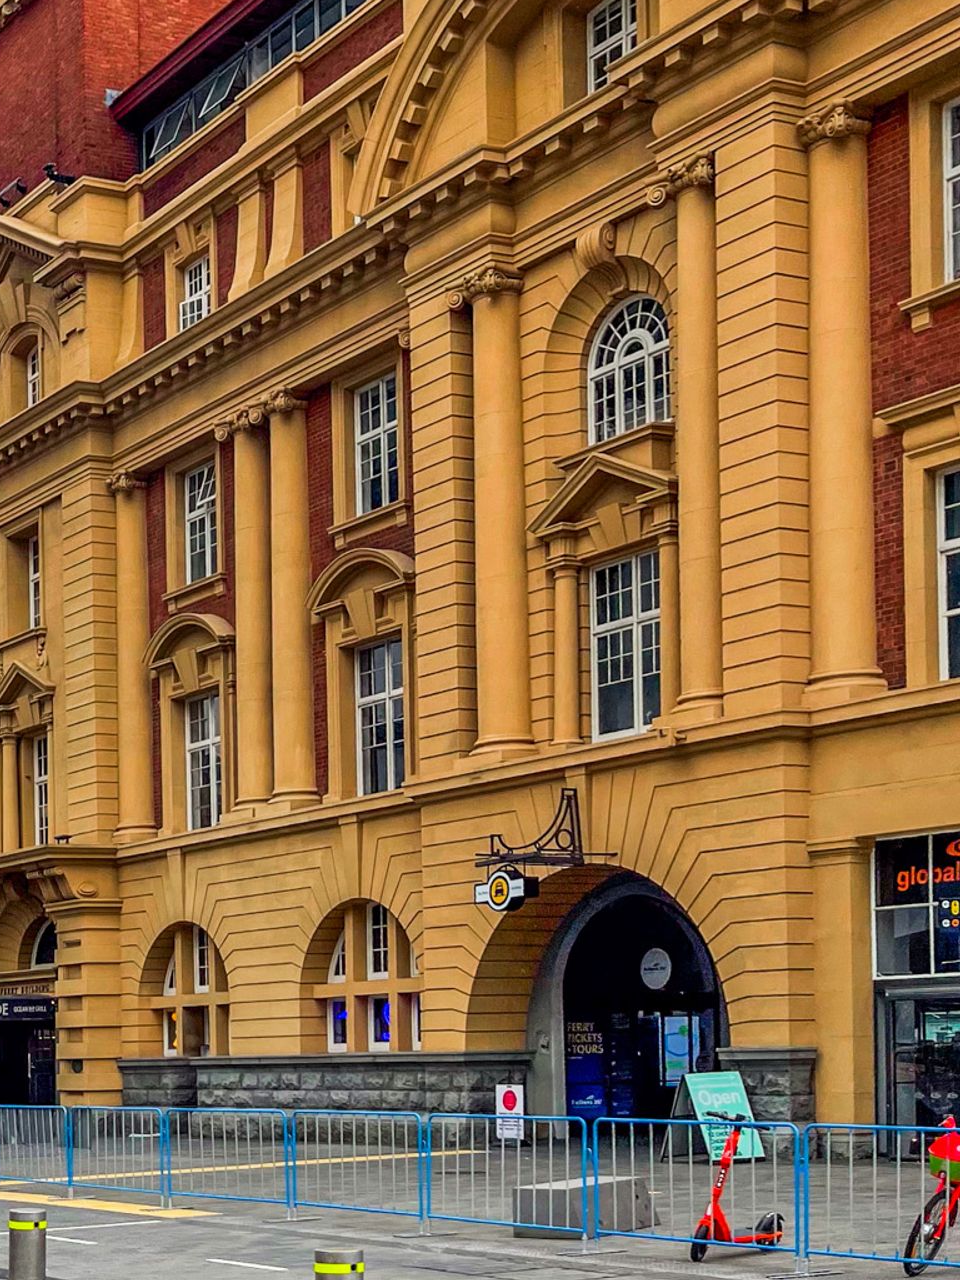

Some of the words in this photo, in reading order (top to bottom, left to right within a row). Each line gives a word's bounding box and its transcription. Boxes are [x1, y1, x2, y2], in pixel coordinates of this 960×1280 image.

[567, 1022, 594, 1032] FERRY
[567, 1033, 603, 1043] TICKETS
[572, 1044, 604, 1054] TOURS
[698, 1090, 741, 1107] Open
